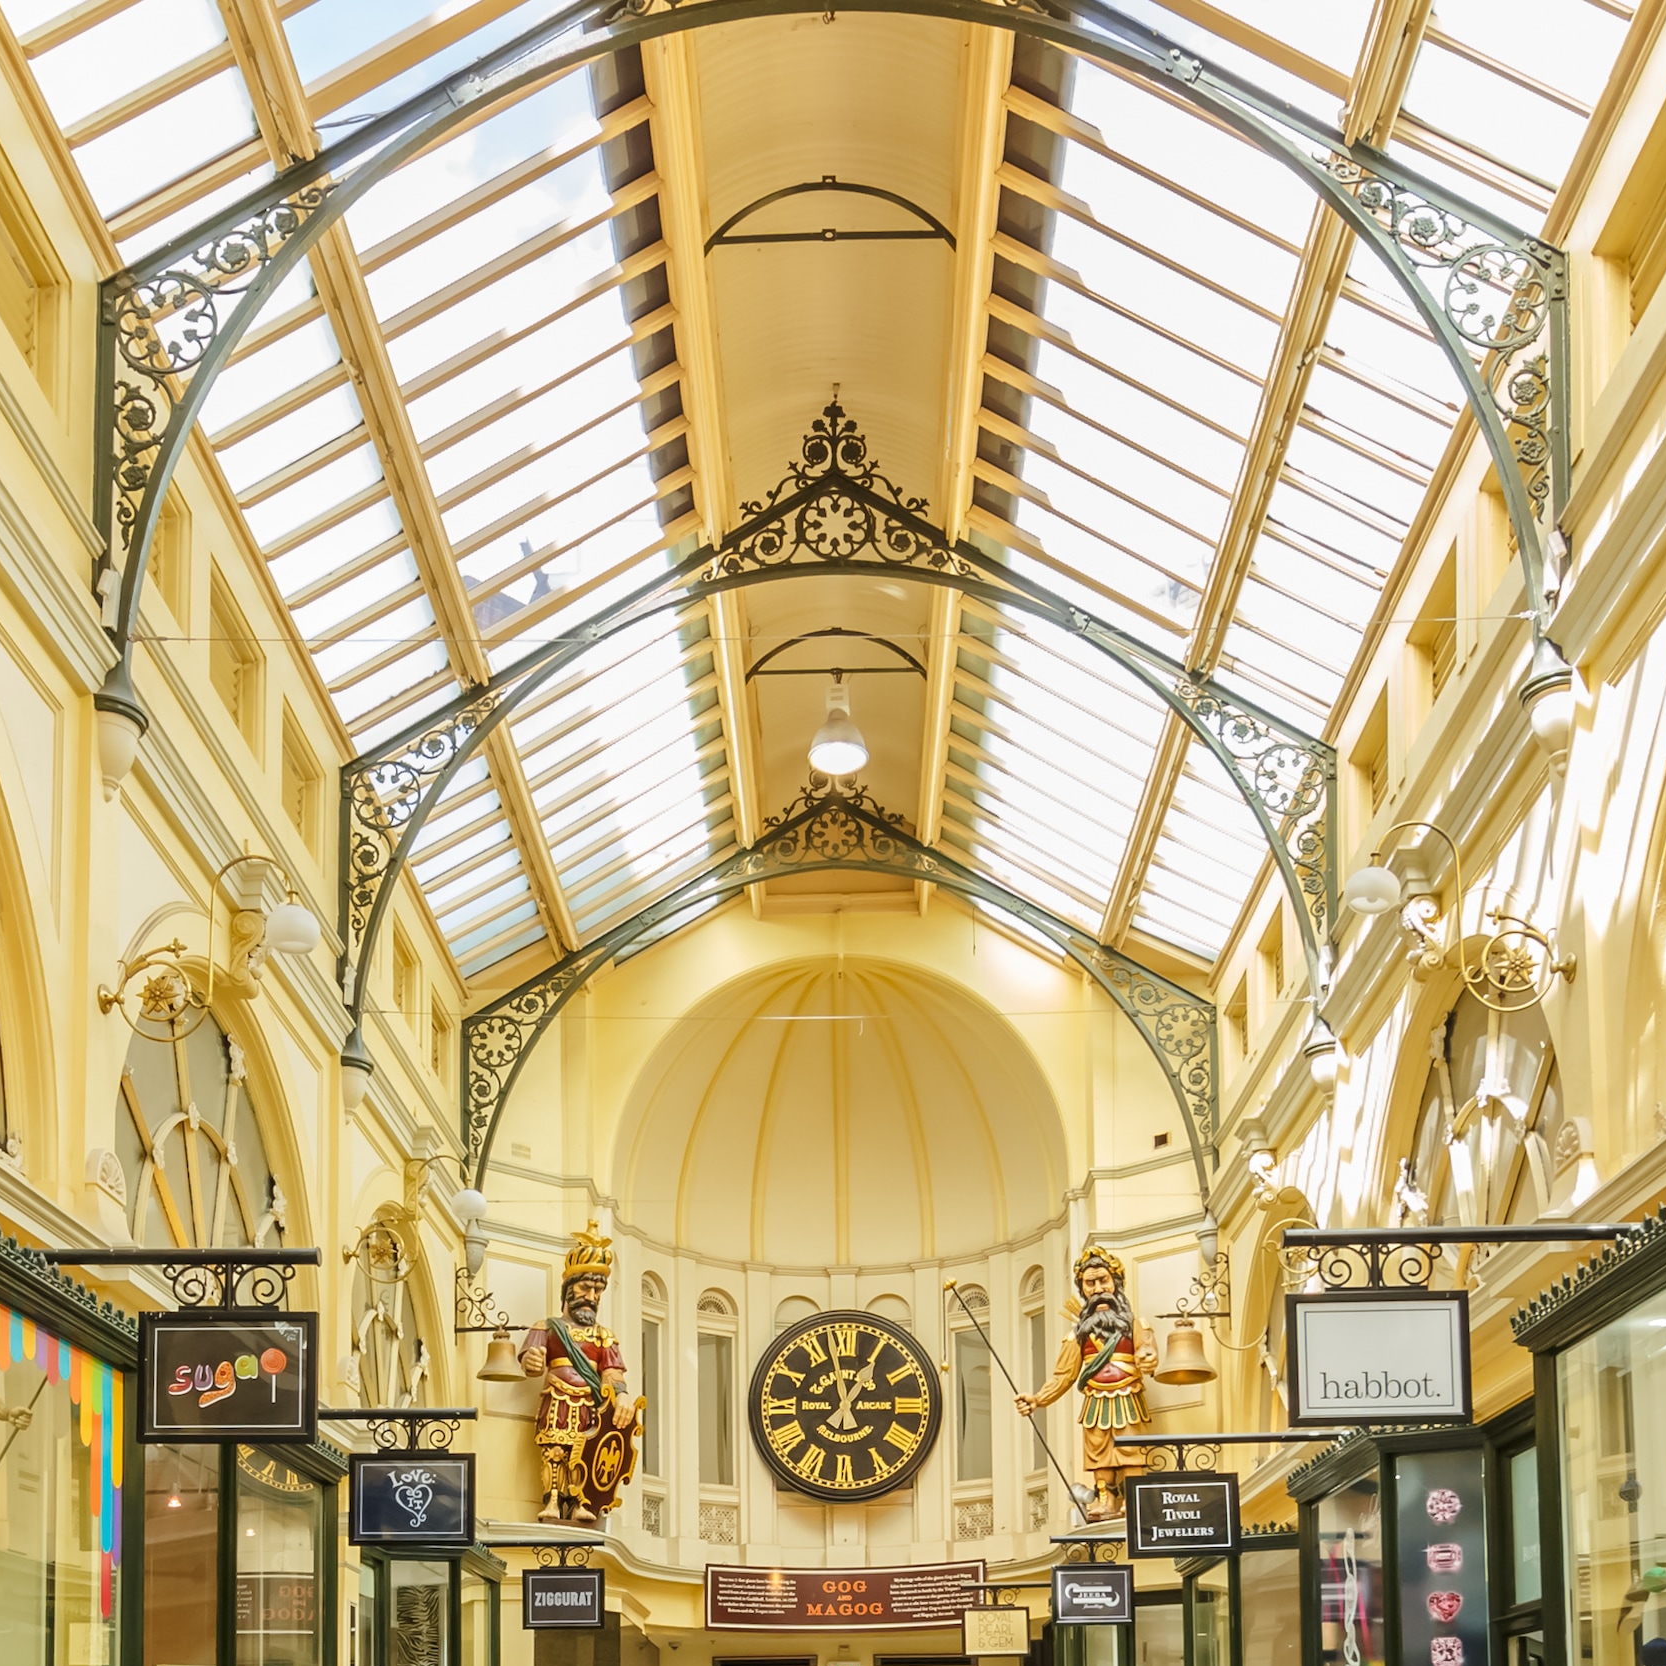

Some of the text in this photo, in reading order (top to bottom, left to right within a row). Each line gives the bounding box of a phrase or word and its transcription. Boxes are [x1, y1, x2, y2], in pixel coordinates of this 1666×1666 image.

[1319, 1371, 1441, 1399] habbot.
[802, 1401, 892, 1410] ROYAL ARCADE
[1161, 1492, 1200, 1504] ROYAL
[1162, 1509, 1201, 1521] TIVOLI
[1151, 1526, 1214, 1541] JEWELLERS
[822, 1580, 867, 1593] GOG
[534, 1591, 593, 1606] ZIGGURAT
[806, 1602, 884, 1616] MAGOG
[978, 1611, 1014, 1623] ROYAL
[978, 1623, 1015, 1636] PEARL
[978, 1636, 1014, 1648] & GEM
